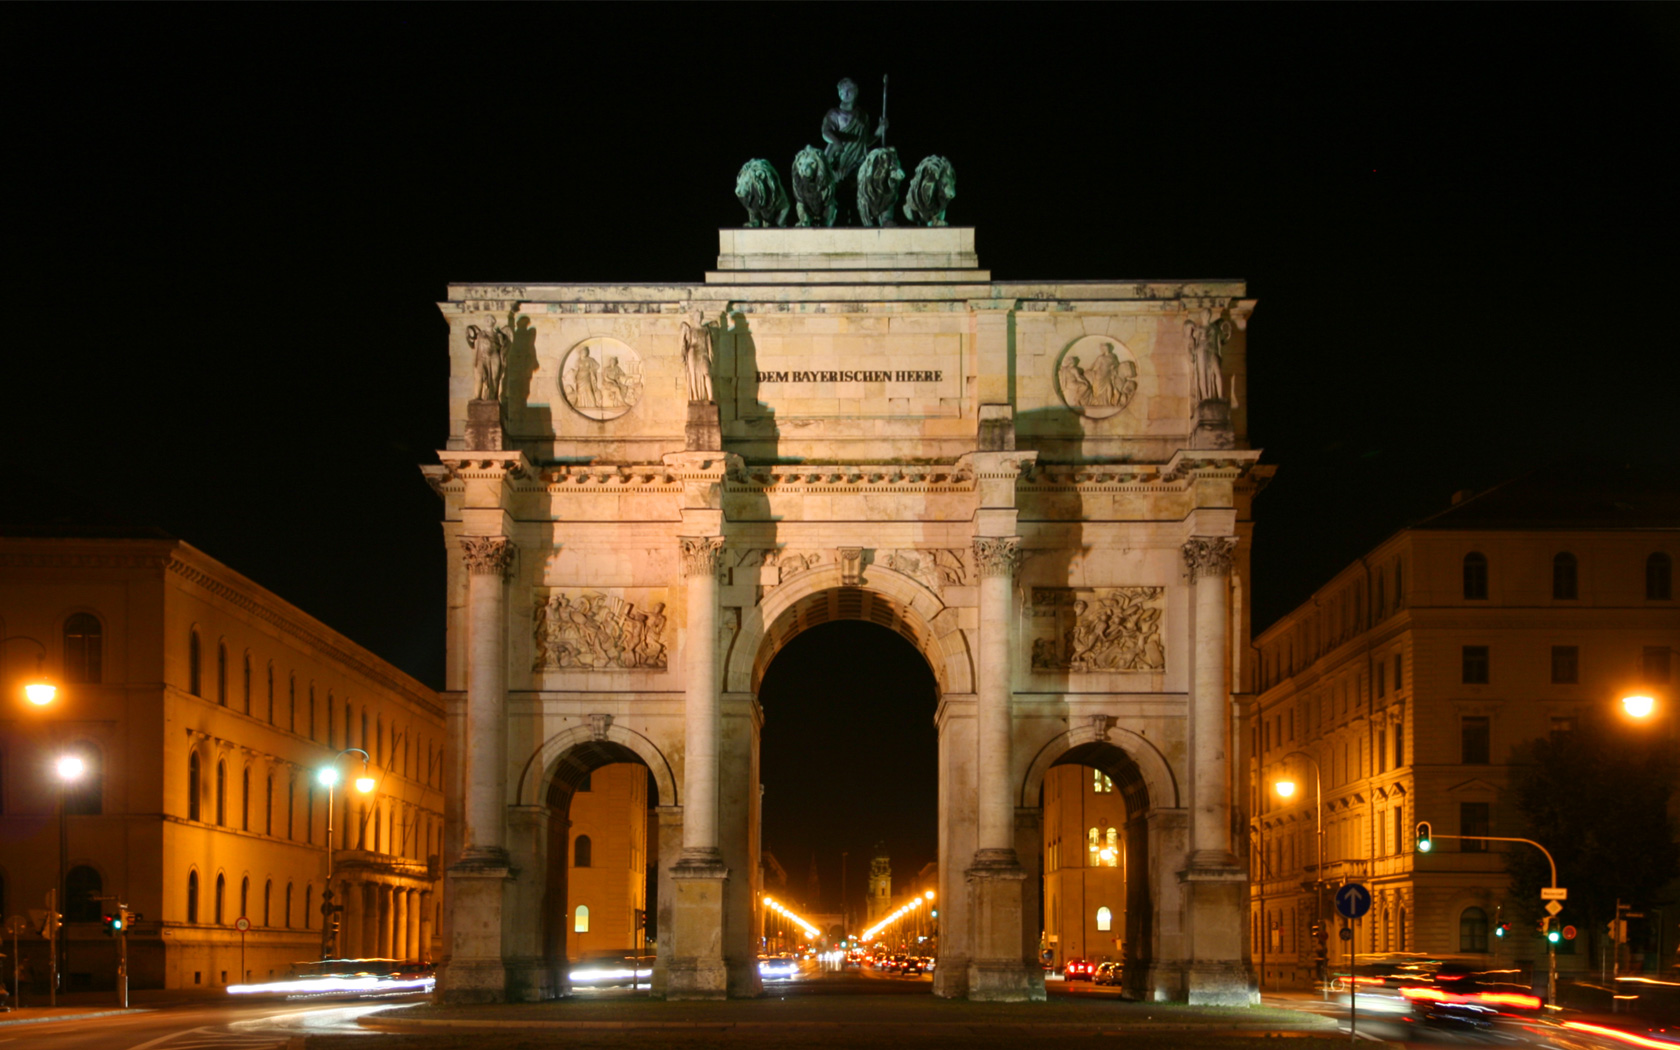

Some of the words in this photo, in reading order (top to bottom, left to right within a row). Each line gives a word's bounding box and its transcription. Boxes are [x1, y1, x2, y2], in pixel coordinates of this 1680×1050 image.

[756, 371, 789, 383] DEM
[792, 371, 893, 383] BAYERISCHEN
[895, 371, 943, 383] HEERE
